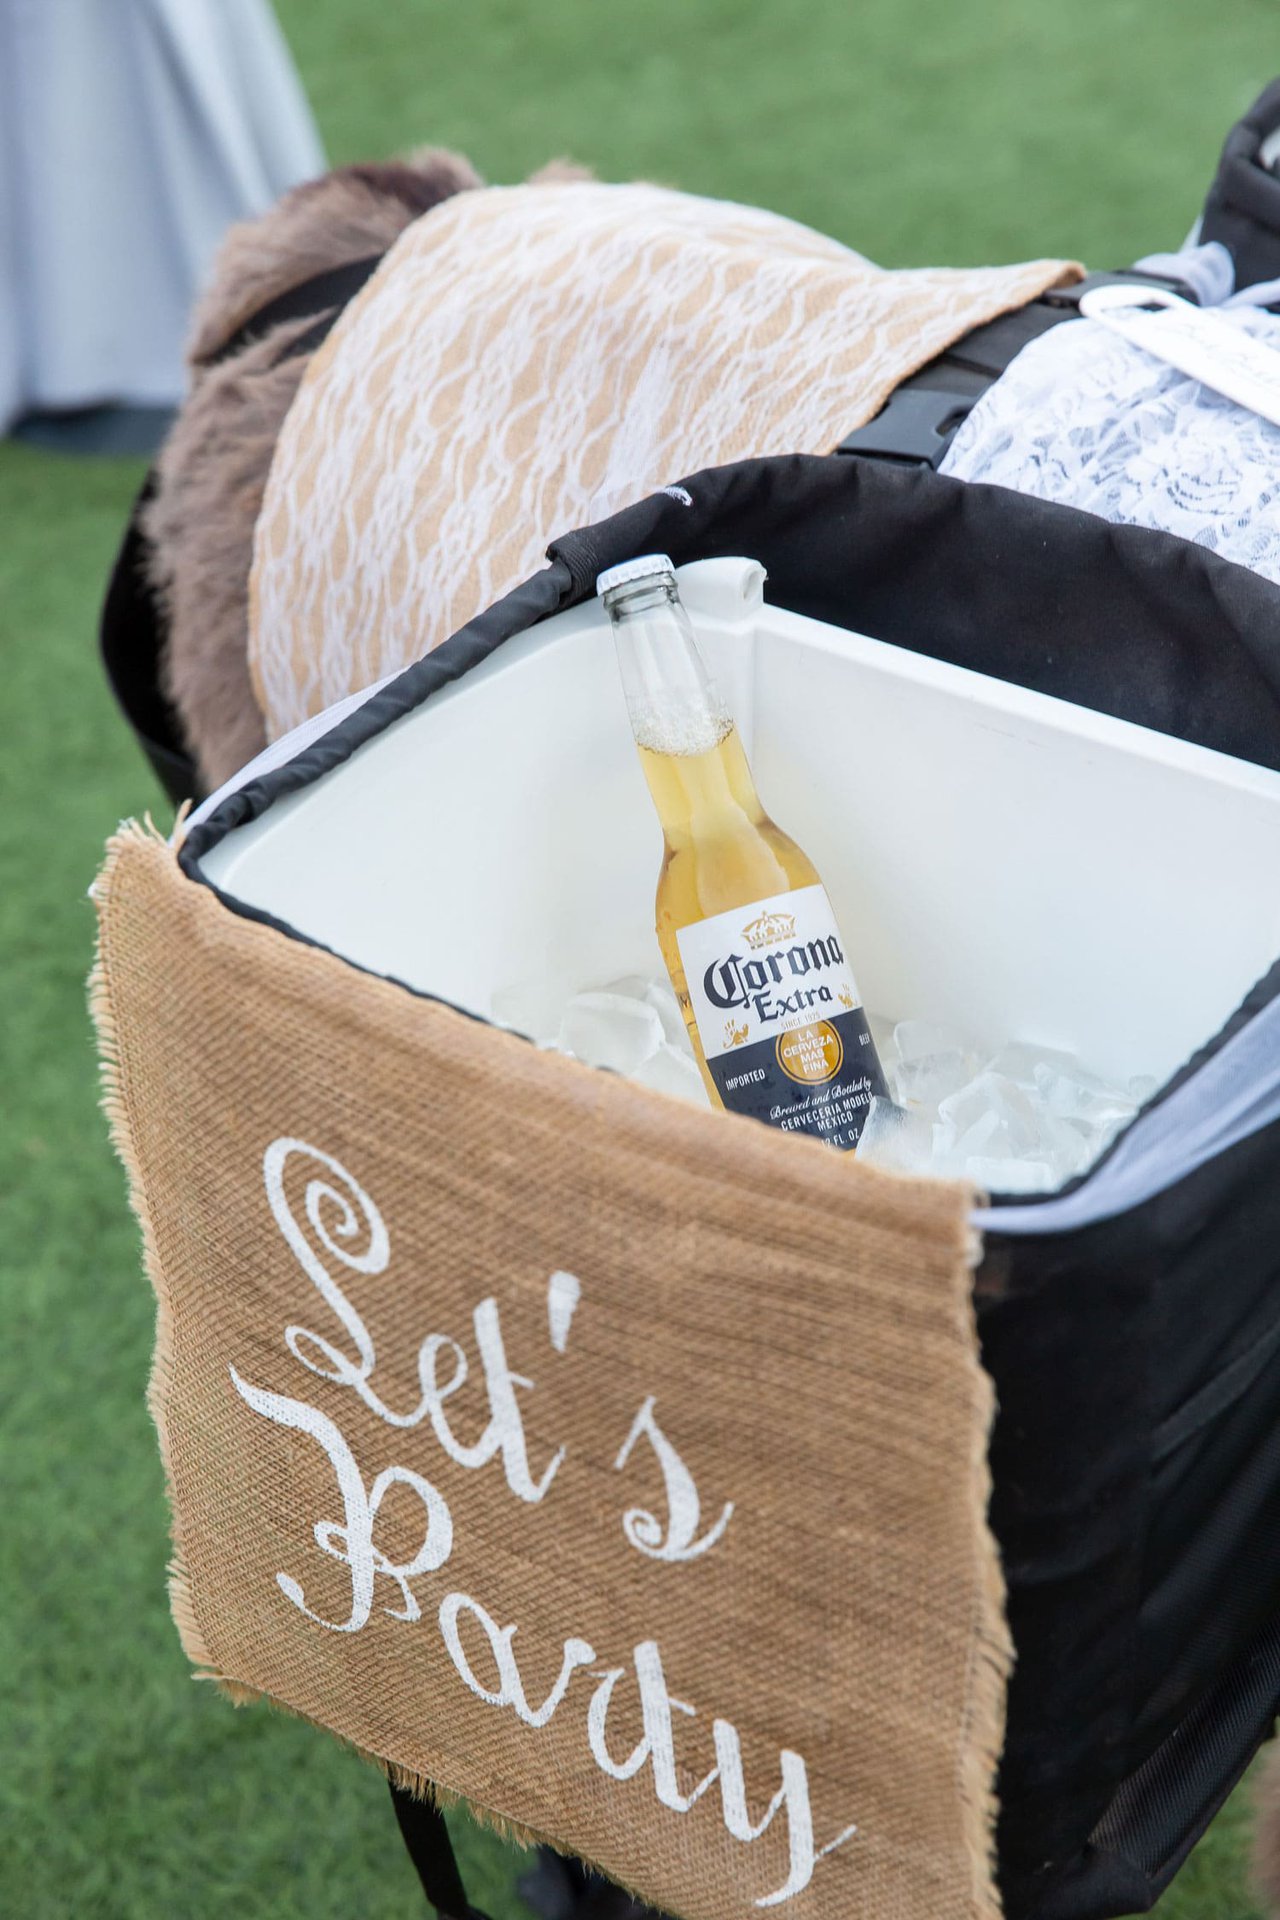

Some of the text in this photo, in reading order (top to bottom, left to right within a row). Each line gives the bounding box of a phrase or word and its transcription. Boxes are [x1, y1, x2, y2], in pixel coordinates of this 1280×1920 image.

[703, 934, 844, 1009] Corona
[752, 984, 833, 1023] Extra
[783, 1034, 834, 1058] CERVEZA
[797, 1030, 814, 1042] LA
[800, 1048, 825, 1063] MAS
[803, 1060, 829, 1074] FINA
[725, 1068, 766, 1091] IMPORTED
[769, 1076, 872, 1120] Brewed and Bottled by
[780, 1091, 873, 1132] CERVECERIA MODELO
[817, 1111, 854, 1132] MEXICO
[263, 1136, 734, 1562] Let's
[228, 1362, 858, 1907] Party
